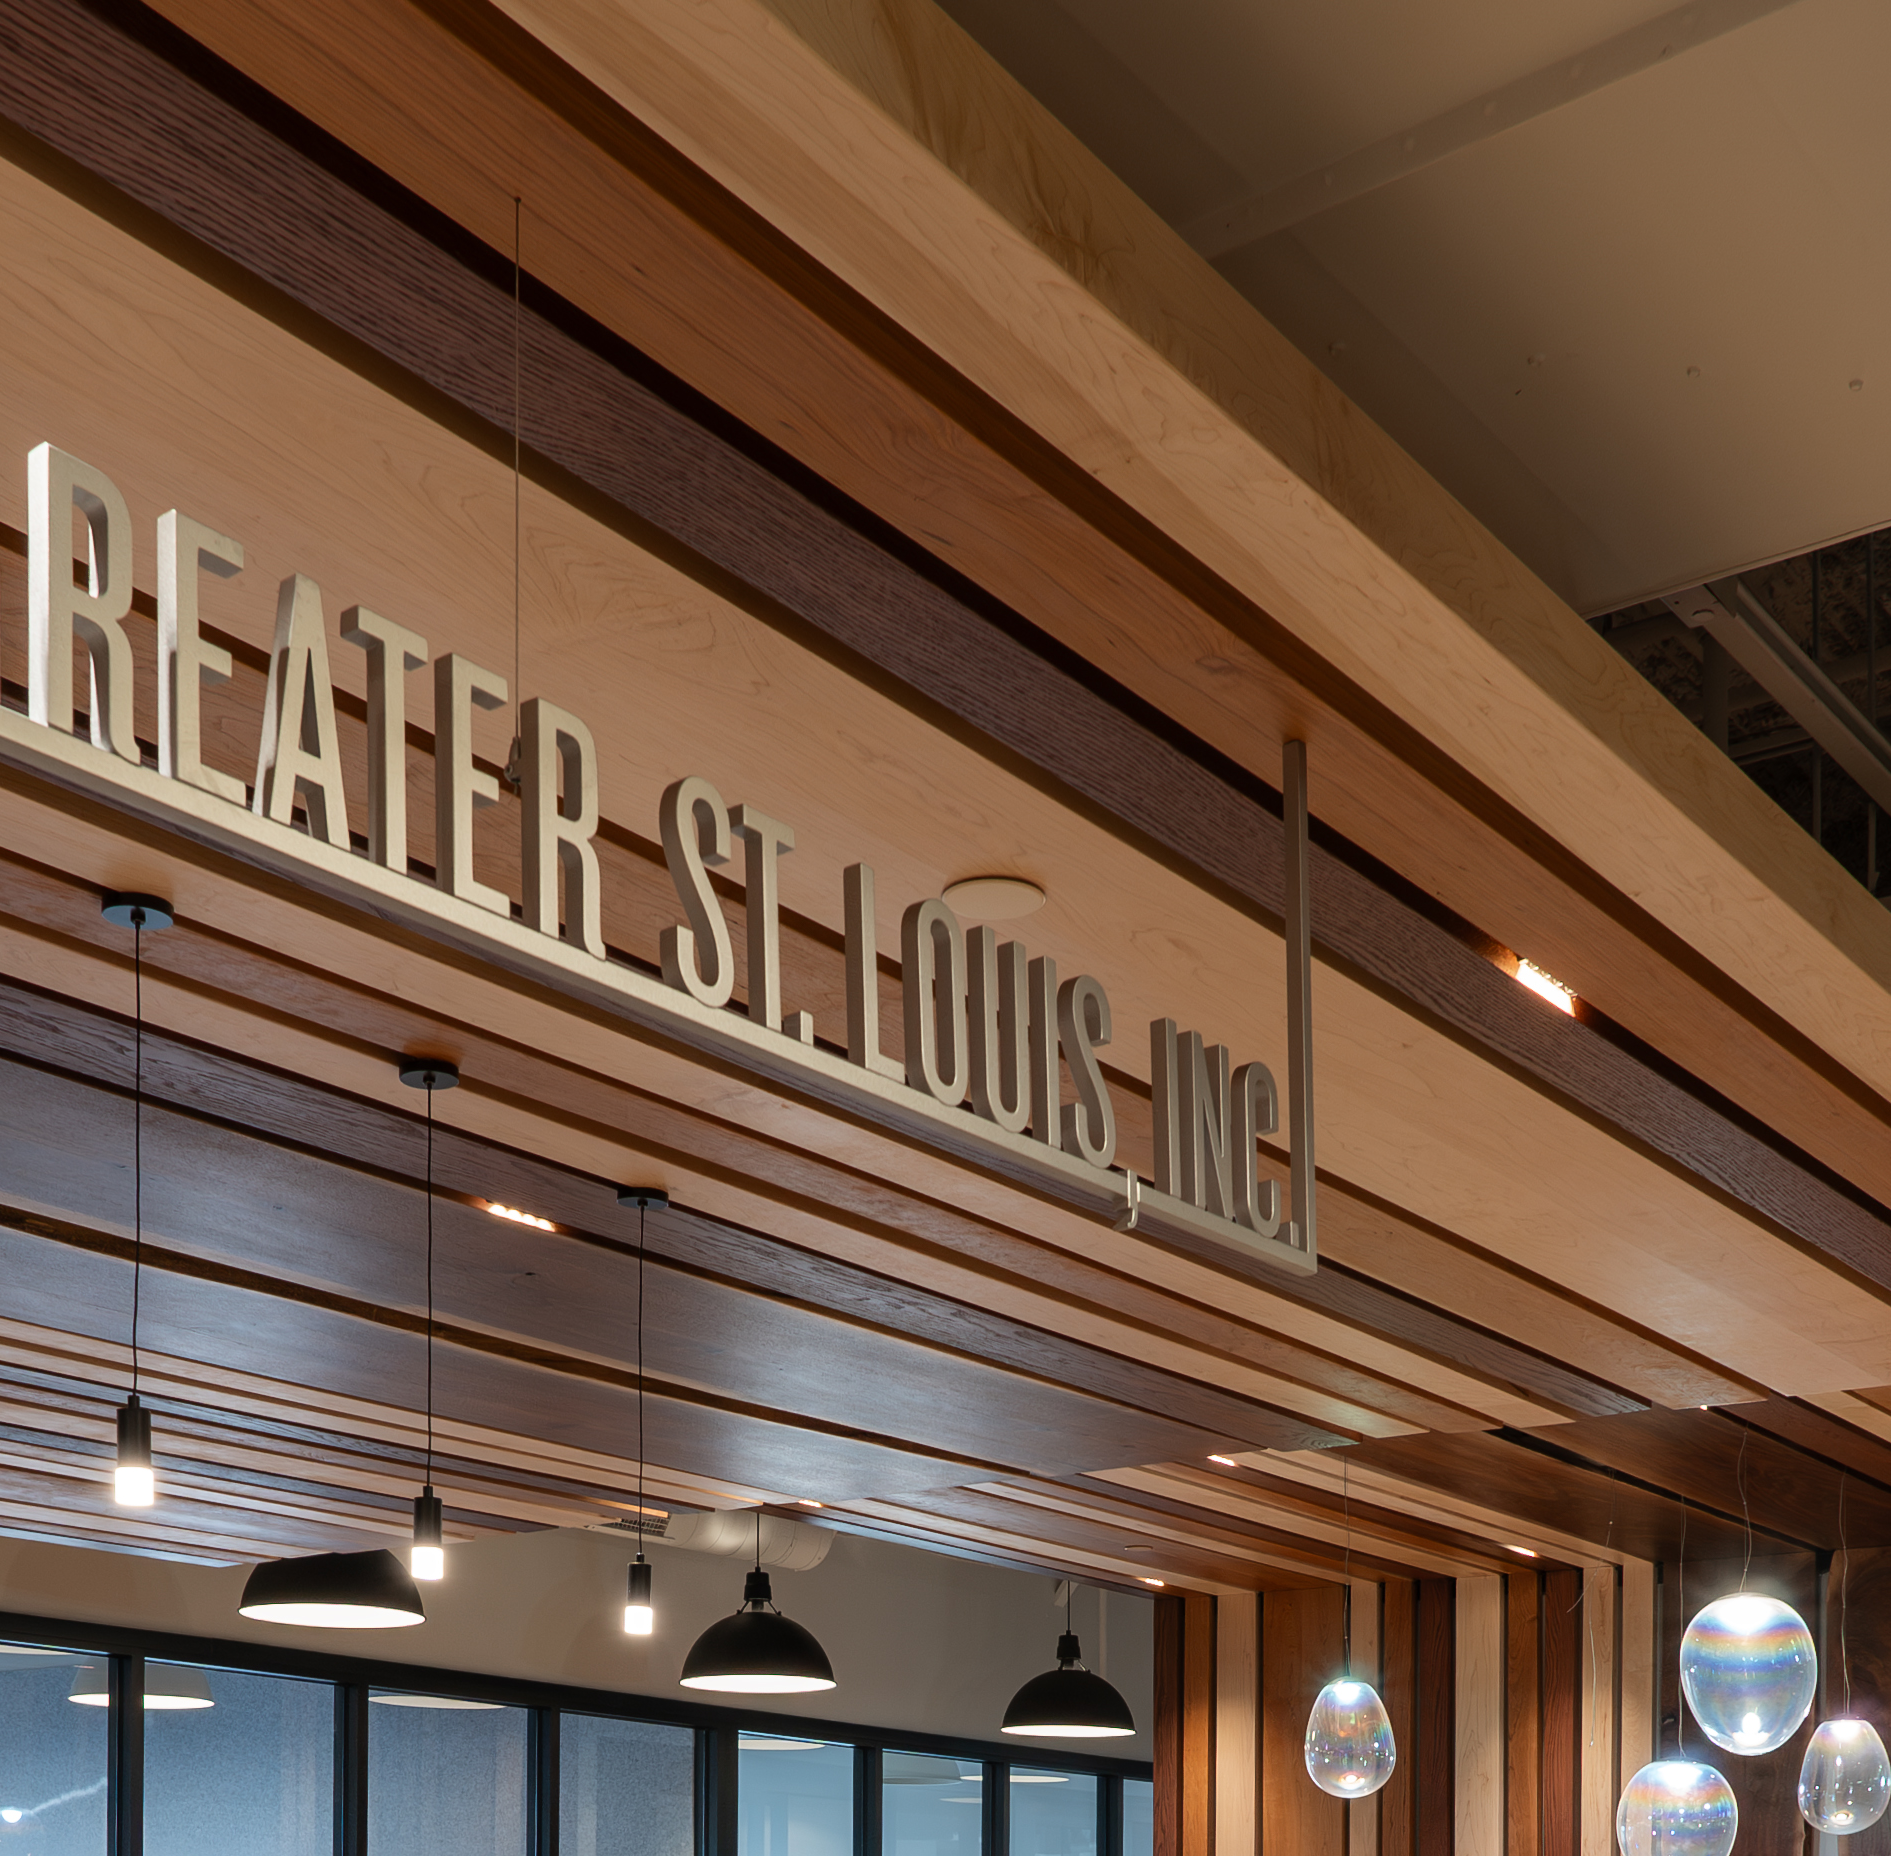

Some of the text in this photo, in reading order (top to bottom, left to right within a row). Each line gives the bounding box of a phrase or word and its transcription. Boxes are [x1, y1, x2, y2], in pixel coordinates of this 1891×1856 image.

[660, 775, 814, 1047] ST.
[842, 861, 1140, 1232] LOUIS,
[1149, 1016, 1300, 1248] INC.
